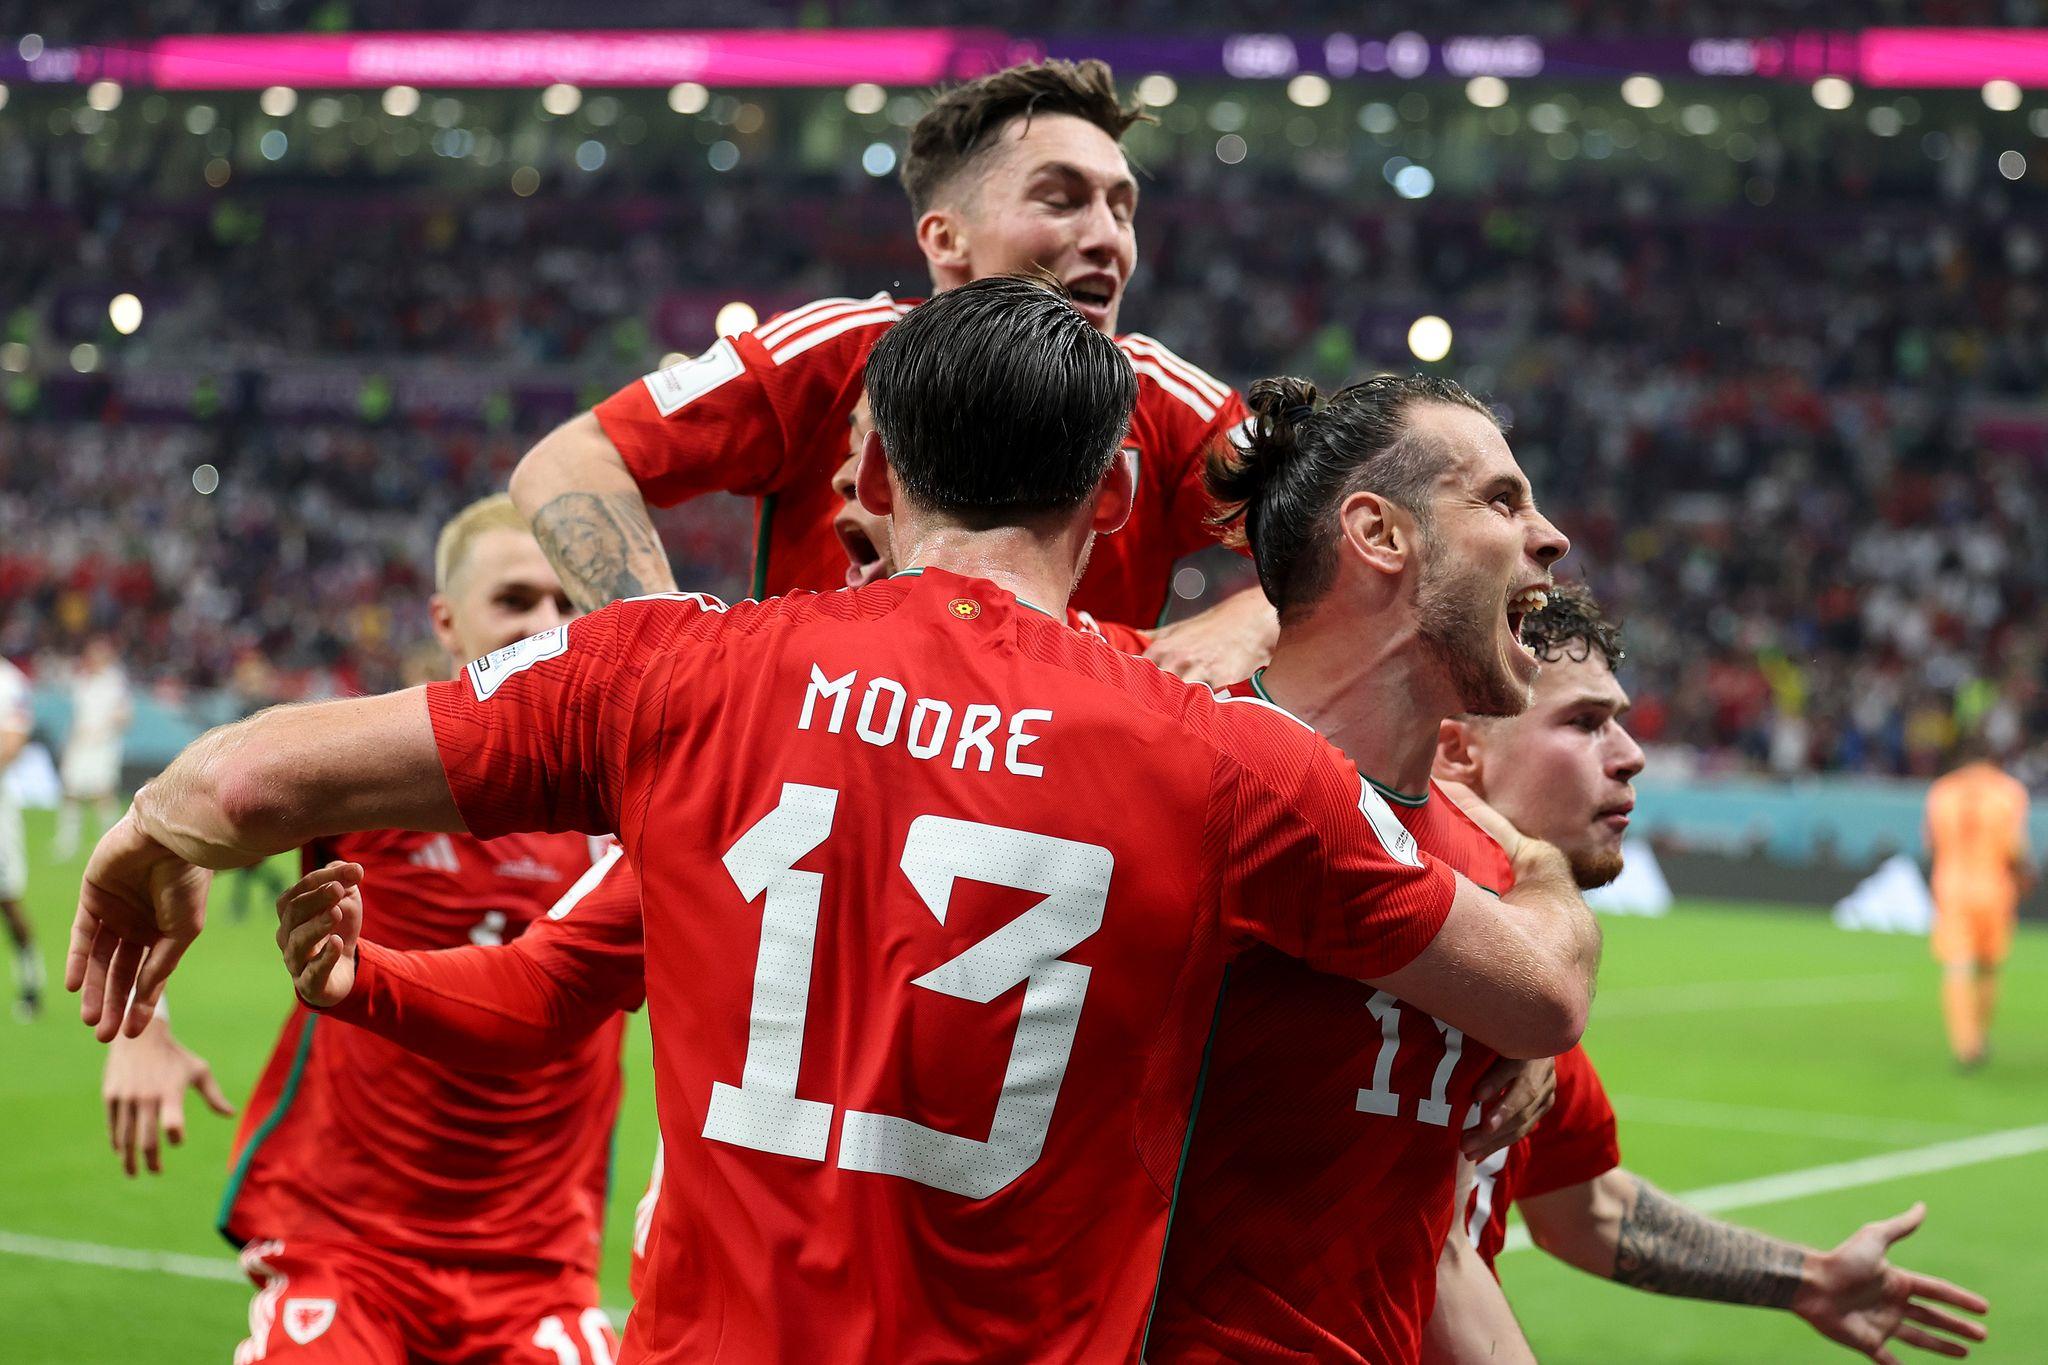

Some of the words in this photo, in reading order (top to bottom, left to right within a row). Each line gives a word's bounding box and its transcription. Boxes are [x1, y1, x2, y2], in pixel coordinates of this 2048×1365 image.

[798, 663, 1053, 777] MOORE
[702, 782, 1114, 1199] 13
[1355, 990, 1463, 1127] 11
